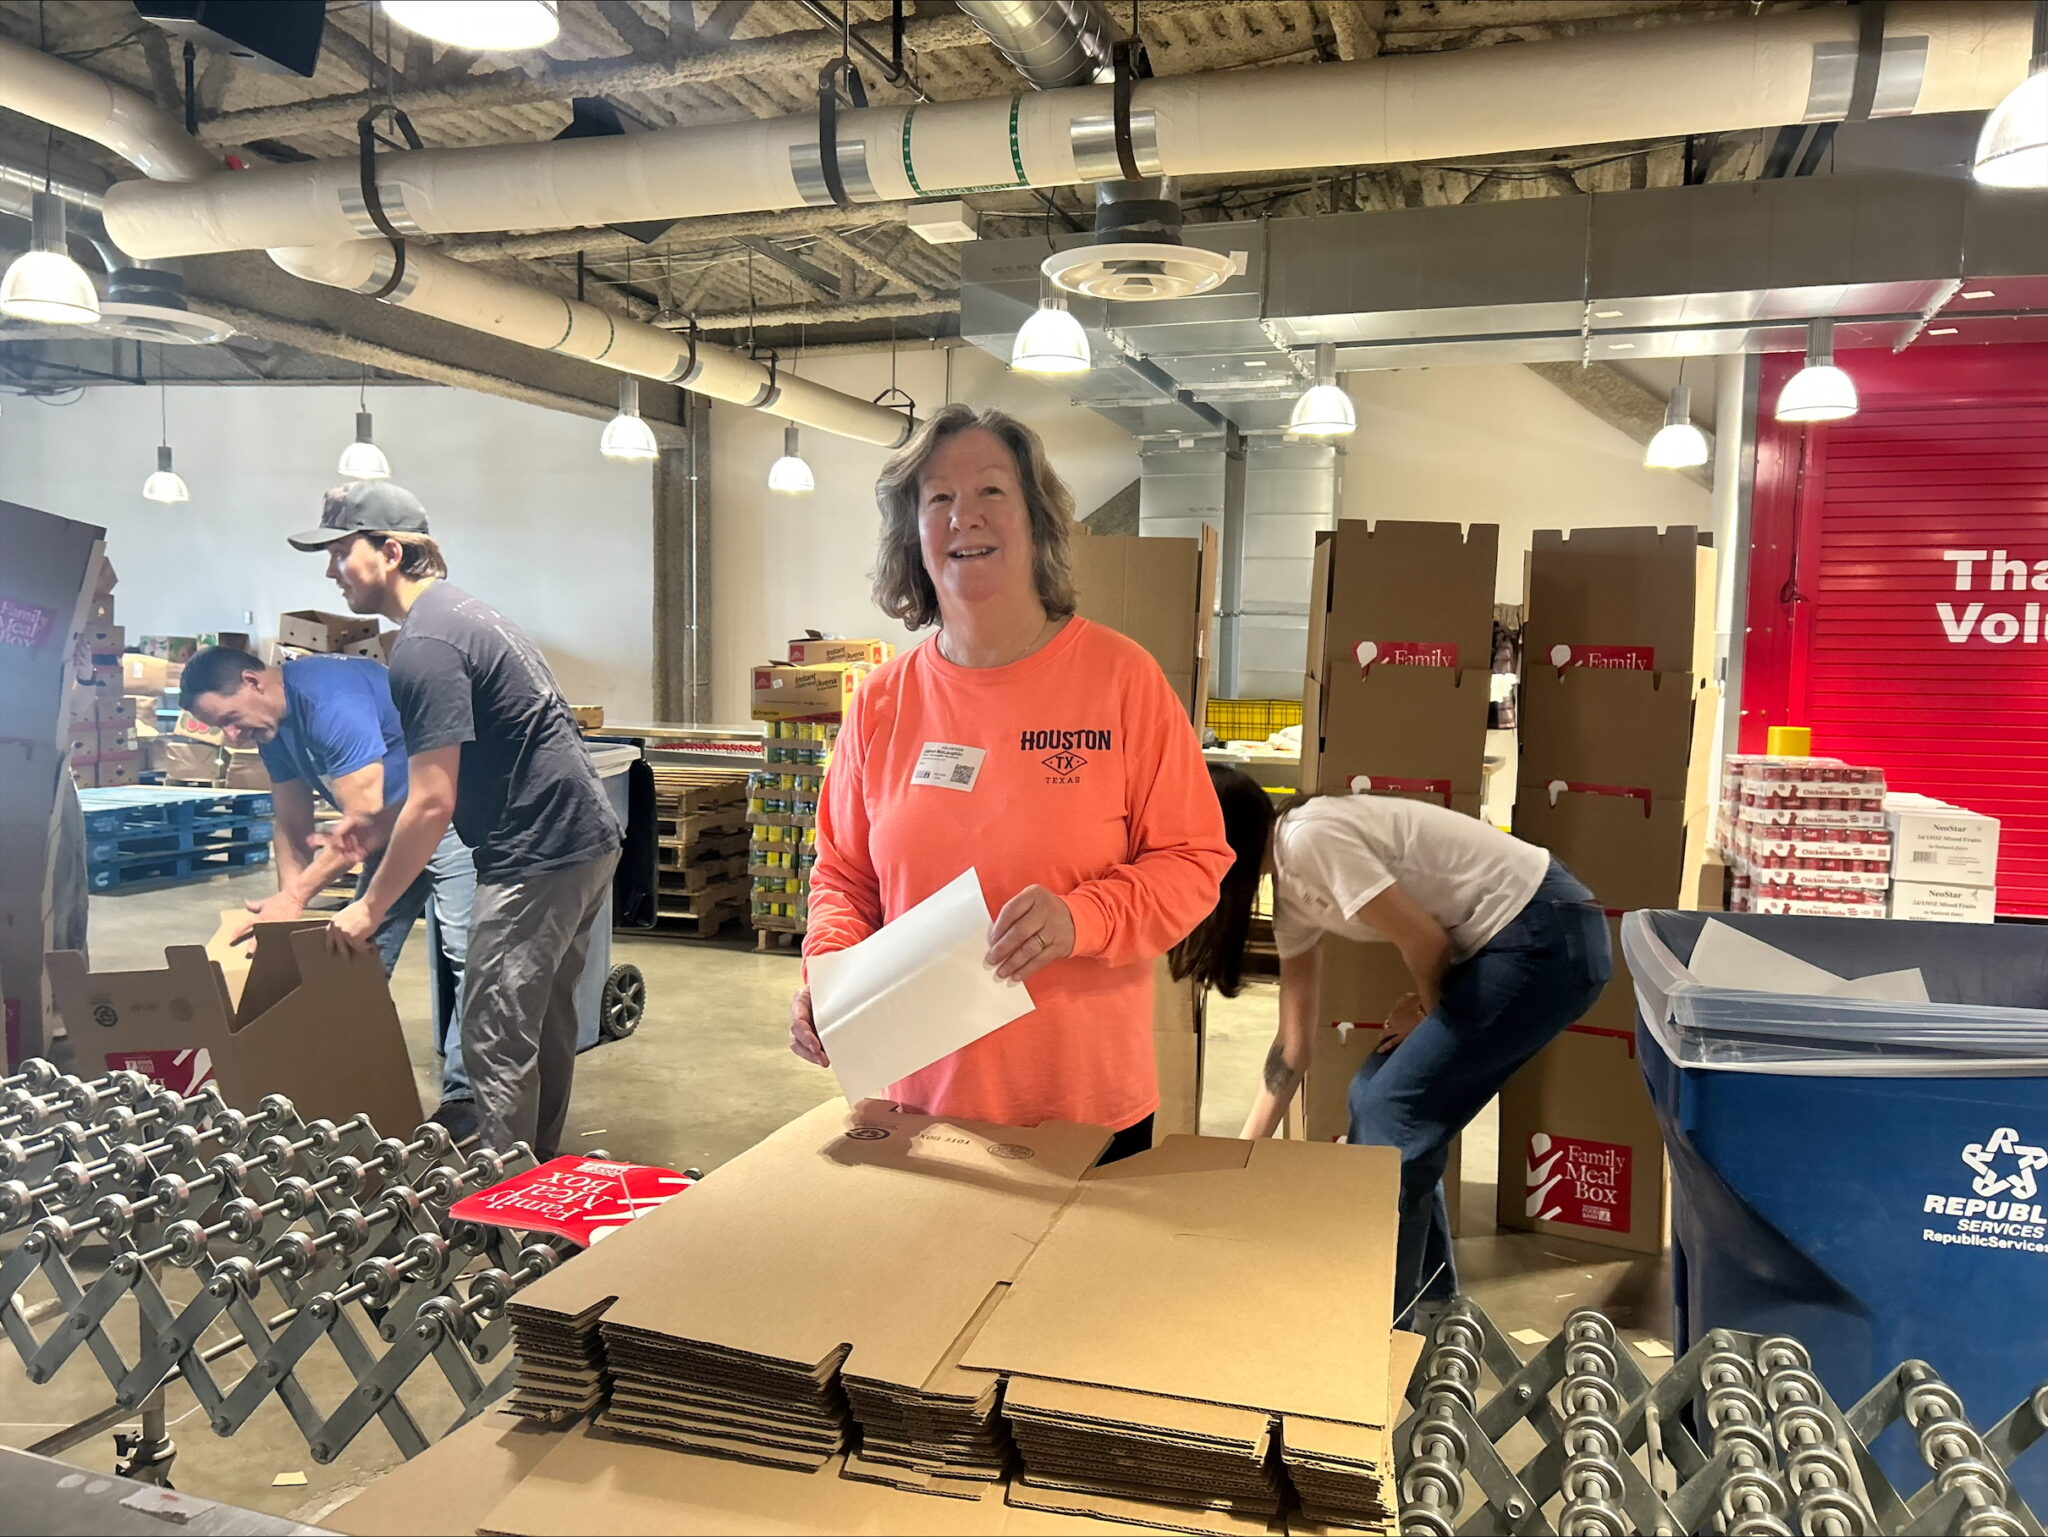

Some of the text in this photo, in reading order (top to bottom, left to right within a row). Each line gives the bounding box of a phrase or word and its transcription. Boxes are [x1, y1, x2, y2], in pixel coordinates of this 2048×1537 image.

[1936, 602, 2048, 643] Vol
[1020, 728, 1111, 751] HOUSTON
[1055, 756, 1074, 770] TX
[1045, 776, 1080, 785] TEXAS
[1803, 788, 1827, 796] Chicken
[1933, 824, 1967, 832] NeoStar
[1929, 890, 1962, 899] NeoStar
[1568, 1145, 1625, 1174] Family
[1564, 1161, 1615, 1186] Meal
[514, 1183, 614, 1210] Meal
[1574, 1181, 1617, 1205] Box
[479, 1190, 582, 1222] Family
[1923, 1194, 2048, 1225] REPUBL
[1957, 1218, 2045, 1239] SERVICES
